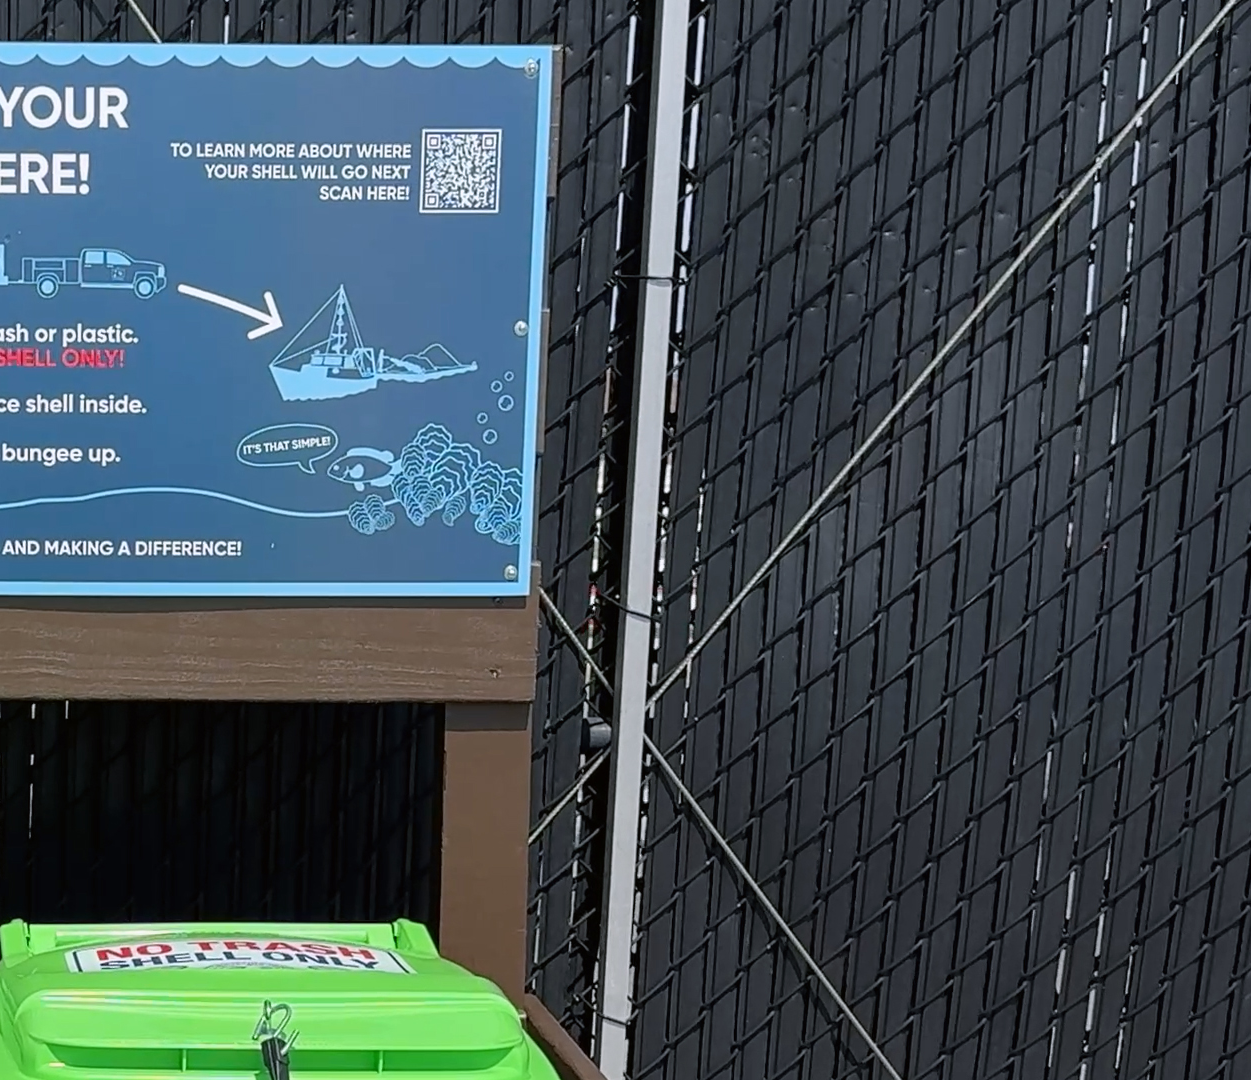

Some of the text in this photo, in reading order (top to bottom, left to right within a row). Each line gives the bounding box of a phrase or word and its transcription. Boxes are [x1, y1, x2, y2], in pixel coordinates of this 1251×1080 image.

[171, 143, 411, 158] TO LEARN MORE ABOUT WHERE
[205, 164, 411, 179] YOUR SHELL WILL GO NEXT
[319, 186, 410, 201] SCAN HERE!
[35, 328, 57, 342] or
[62, 323, 139, 349] plastic.
[61, 347, 126, 368] ONLY!
[26, 394, 73, 413] shell
[80, 394, 146, 413] inside.
[2, 443, 83, 466] bungee
[89, 448, 120, 466] up.
[243, 436, 331, 455] IT'S THAT SIMPLE!
[2, 540, 40, 555] AND
[45, 541, 114, 555] MAKING
[118, 541, 131, 555] A
[135, 541, 241, 556] DIFFERENCE!
[96, 941, 375, 960] NO TRASH
[100, 952, 380, 969] SHELL ONLY
